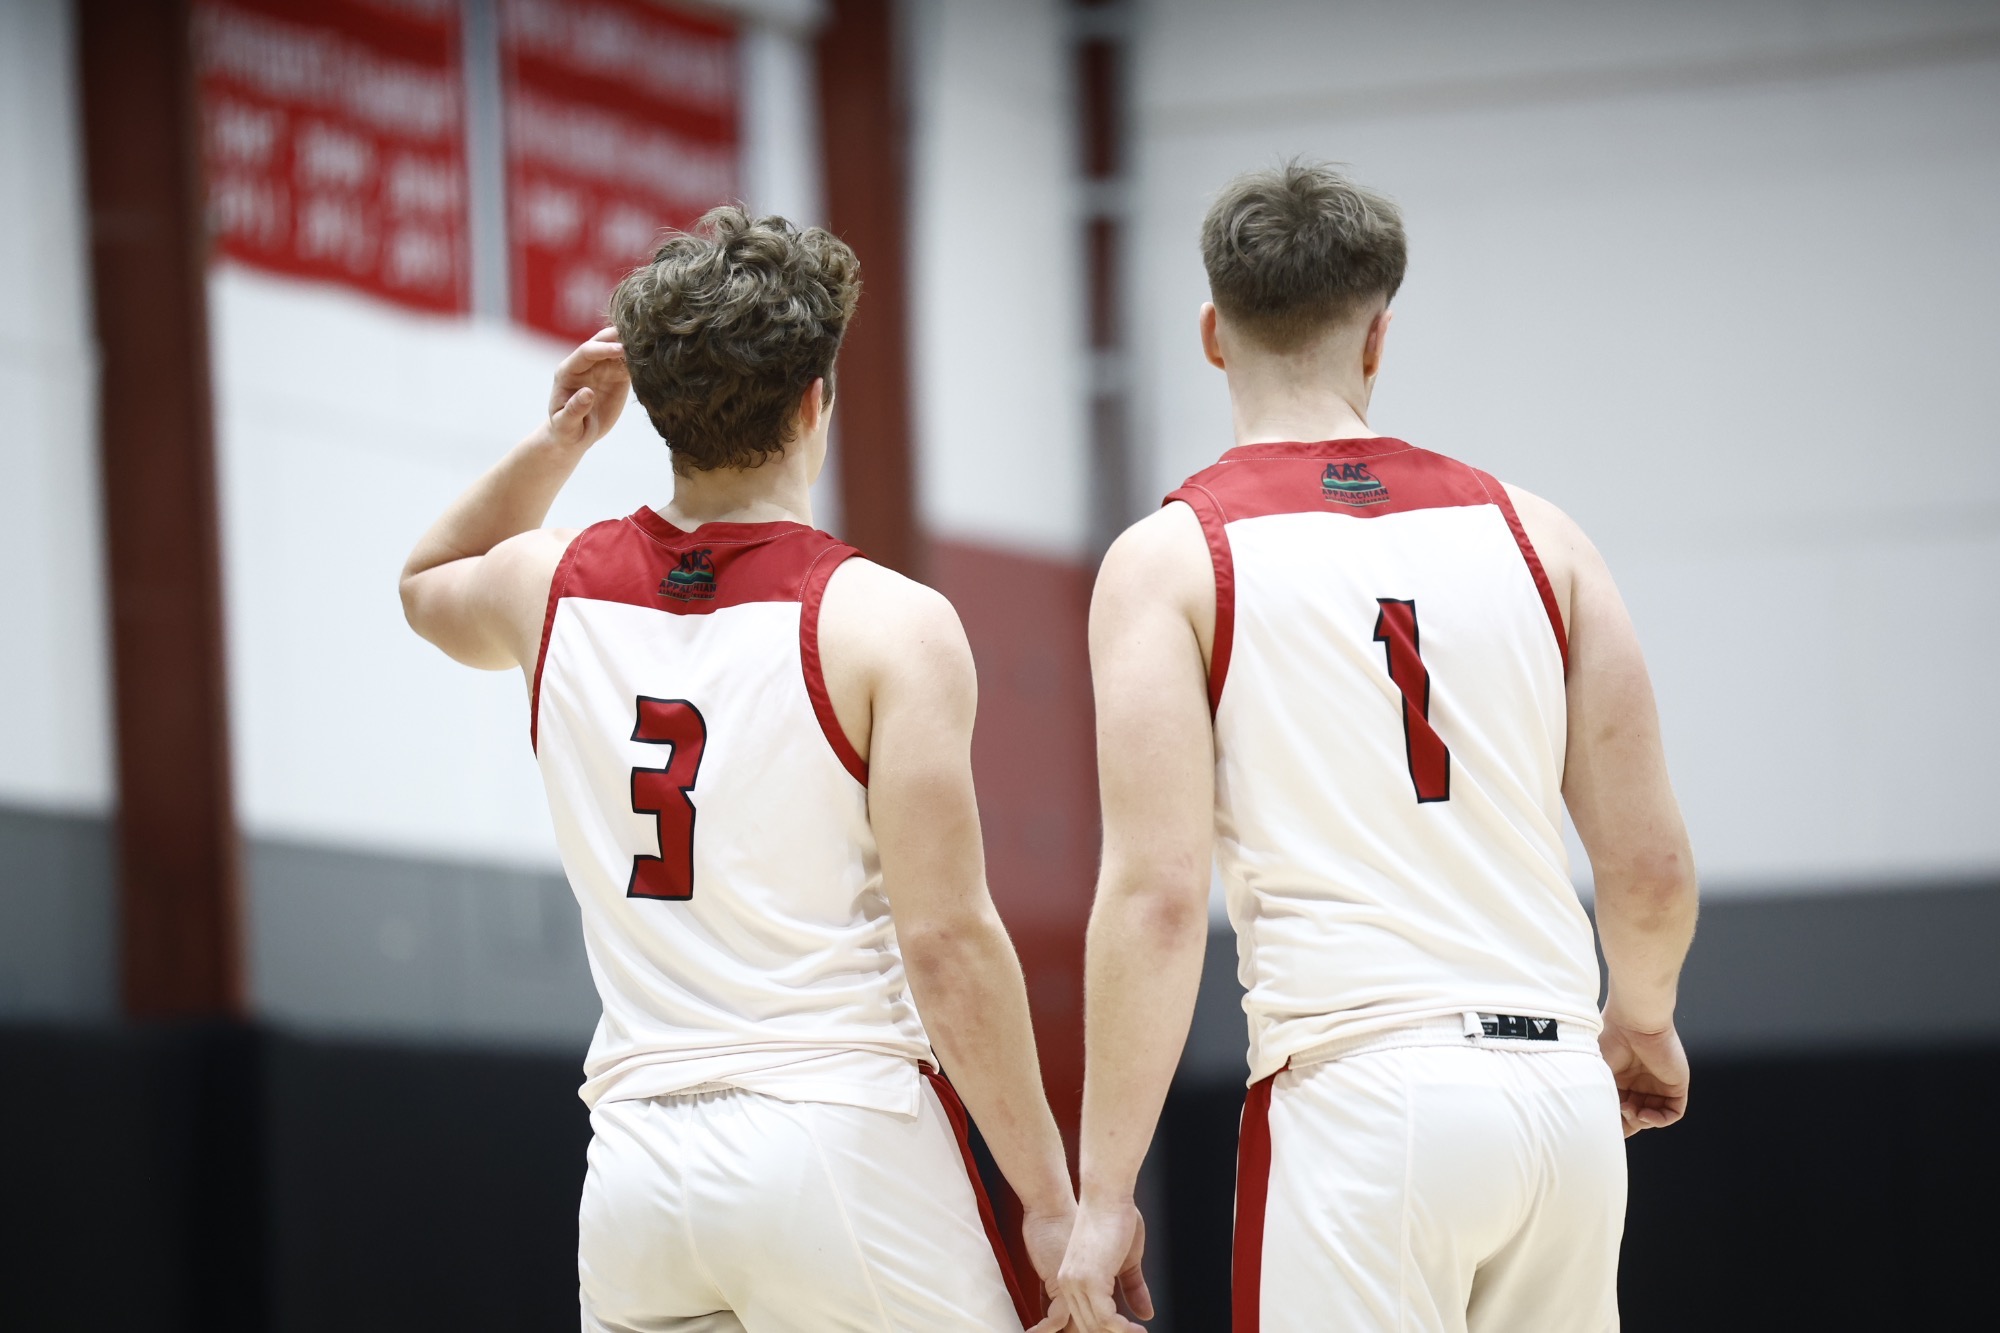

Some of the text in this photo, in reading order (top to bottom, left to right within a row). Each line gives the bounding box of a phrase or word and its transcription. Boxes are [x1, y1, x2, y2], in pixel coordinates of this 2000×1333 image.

[1321, 488, 1389, 500] APPALACHIAN
[1326, 463, 1370, 481] AAC
[1373, 598, 1450, 804] 1
[627, 695, 707, 901] 3
